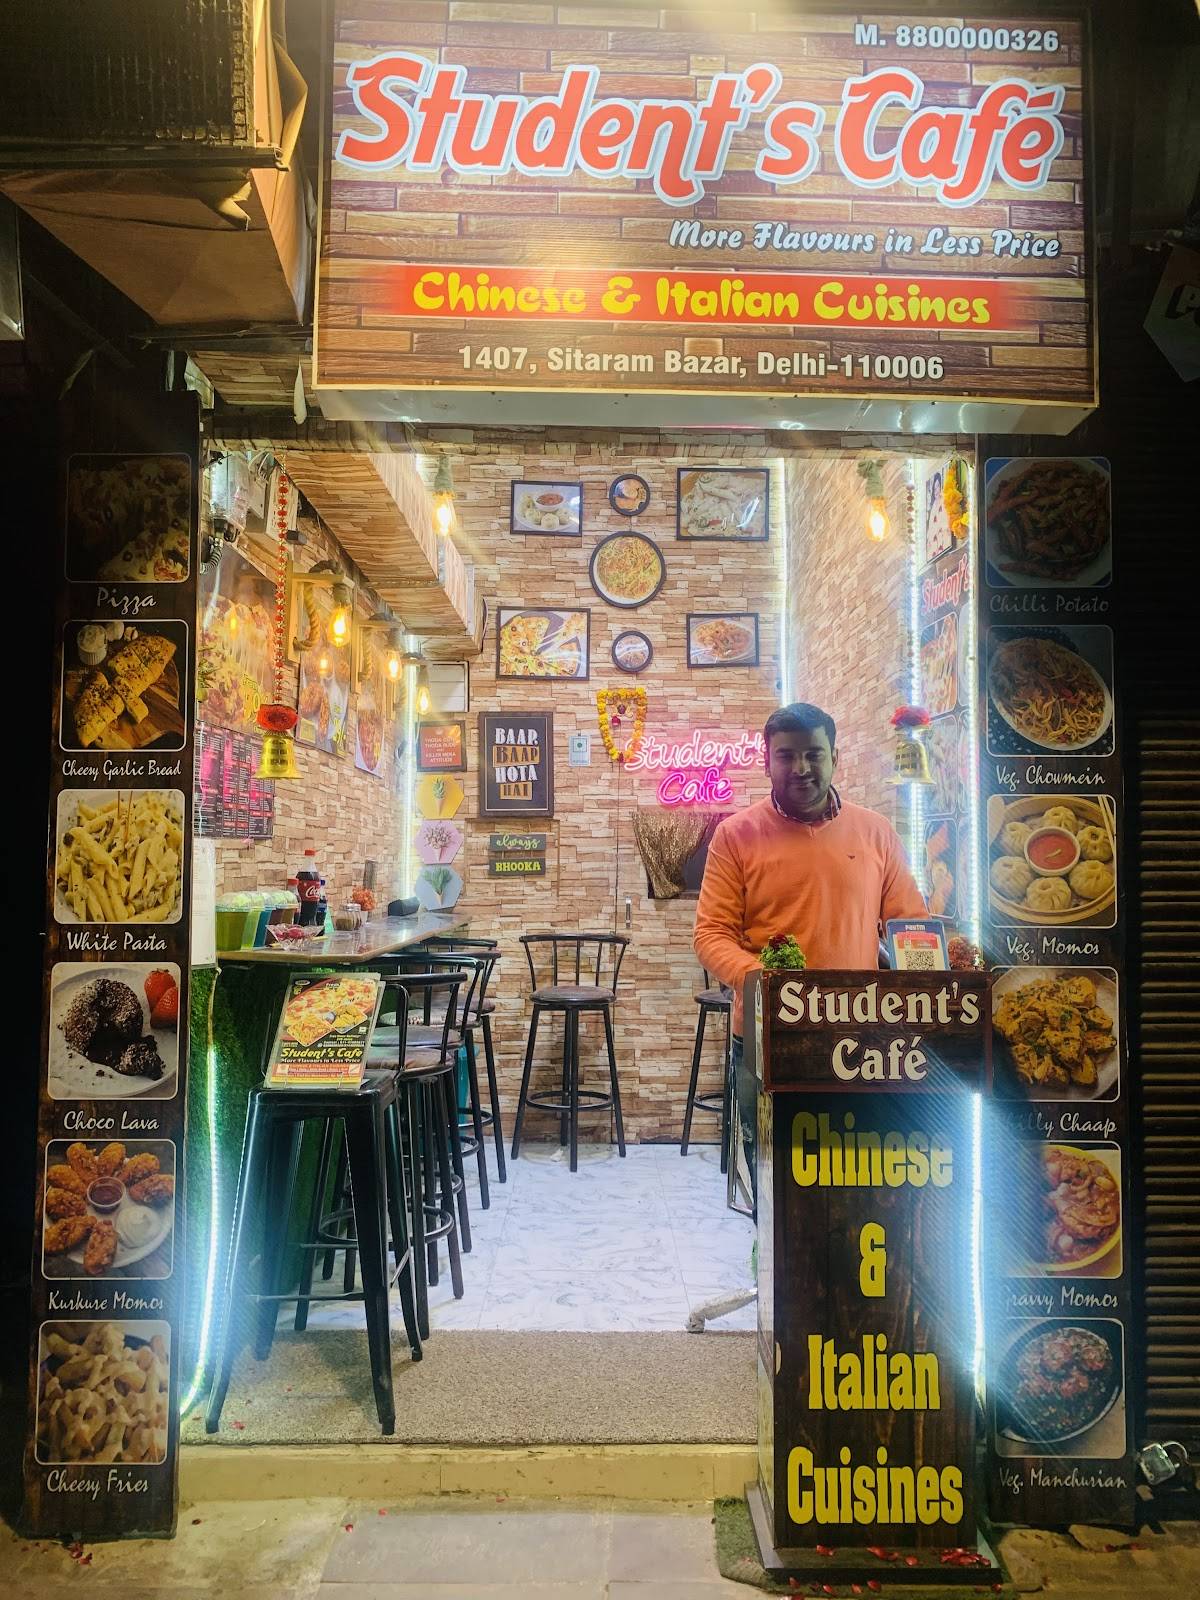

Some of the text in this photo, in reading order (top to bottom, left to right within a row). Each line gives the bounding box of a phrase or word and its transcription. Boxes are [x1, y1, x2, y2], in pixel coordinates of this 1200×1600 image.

[854, 23, 1059, 52] M. 8800000326
[335, 51, 1066, 208] Student's Café
[669, 220, 1061, 259] More Flavours in Less Price
[413, 271, 992, 325] Chinese & Italian Cuisines
[458, 345, 945, 381] 1407, Sitaram Bazar, Delhi-110006
[96, 587, 157, 616] Pizza
[989, 594, 1110, 614] Chilli Potato
[61, 759, 182, 781] Cheesy Garlic Bread
[495, 764, 538, 783] HOTA
[996, 765, 1106, 793] Veg. Chowmein
[659, 768, 733, 806] Cafe
[496, 833, 541, 849] always
[495, 861, 542, 872] BHOOKA
[66, 931, 167, 952] White Pasta
[1006, 936, 1100, 963] Veg. Momos
[778, 980, 981, 1025] Student's
[280, 1048, 335, 1059] Student's
[831, 1036, 928, 1082] Café
[63, 1111, 160, 1131] Choco Lava
[1060, 1112, 1118, 1138] Chaap
[791, 1111, 953, 1188] Chinese
[859, 1222, 887, 1298] &
[48, 1290, 163, 1311] Kurkure Momos
[1003, 1285, 1119, 1313] ravvy Momos
[808, 1334, 941, 1411] Italian
[46, 1469, 149, 1501] Cheesy Fries
[787, 1446, 964, 1525] Cuisines
[999, 1467, 1128, 1494] Veg. Manchurian
